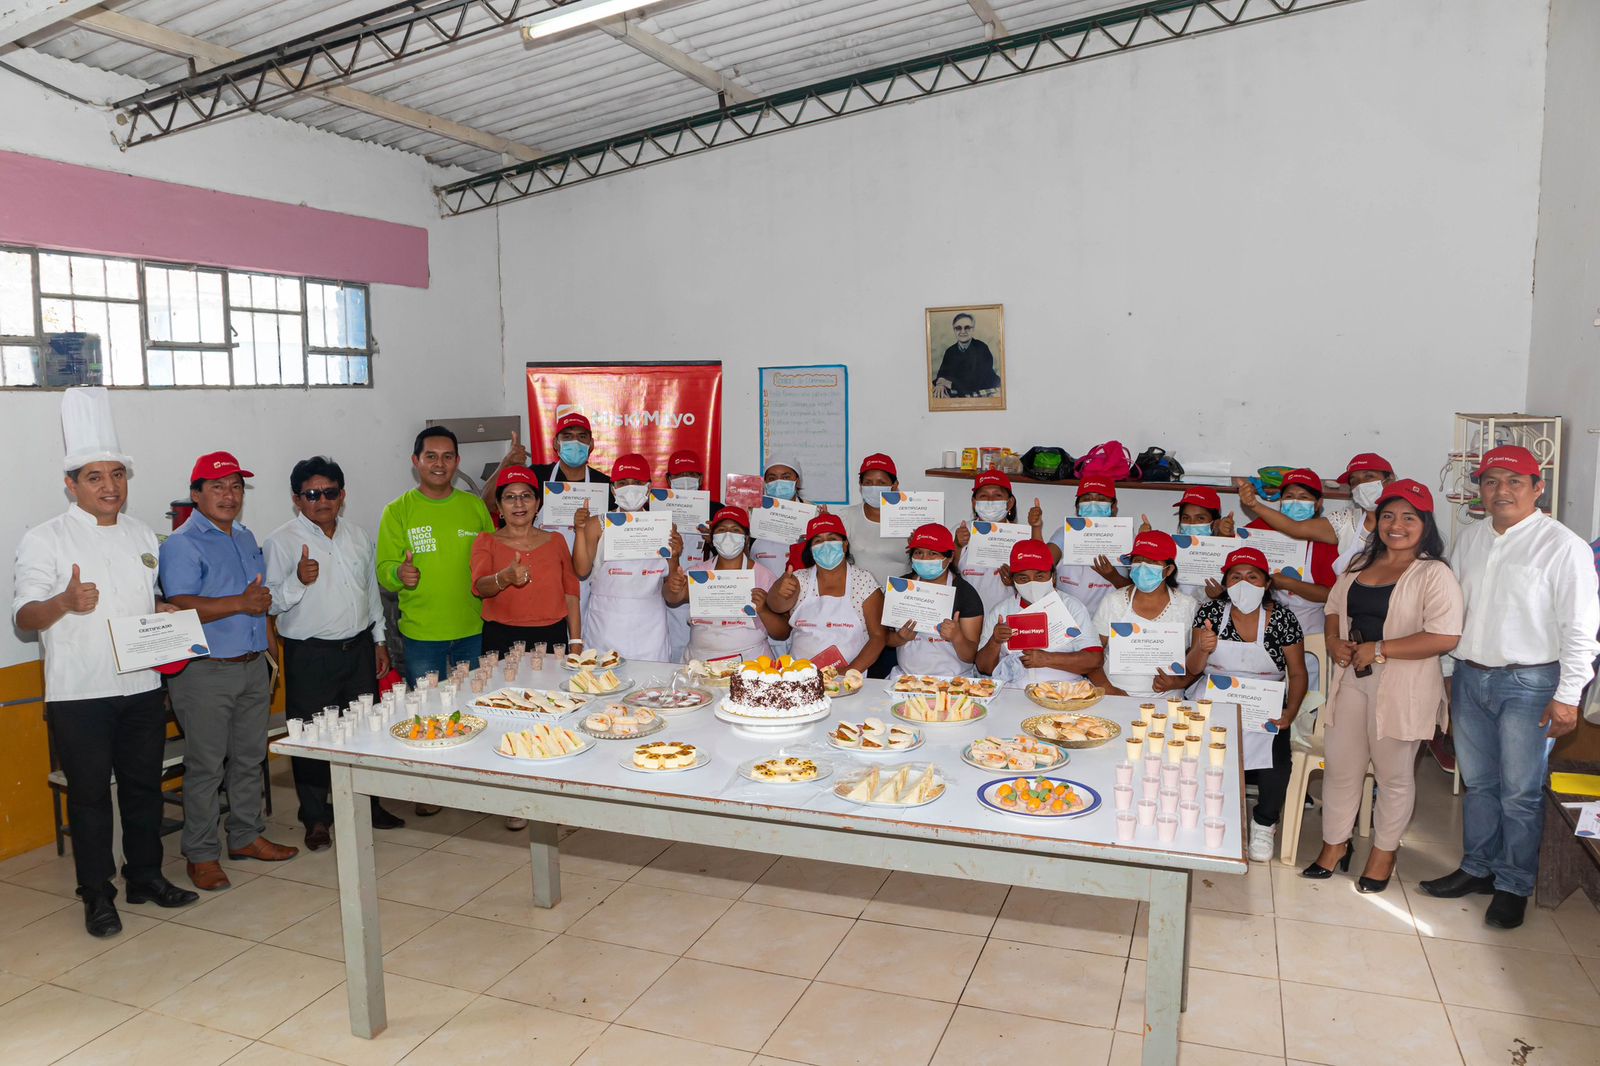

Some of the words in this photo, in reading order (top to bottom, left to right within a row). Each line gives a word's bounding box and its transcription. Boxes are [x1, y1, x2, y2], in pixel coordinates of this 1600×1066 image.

[411, 525, 432, 534] RECO
[412, 532, 431, 540] NOCI
[413, 538, 436, 546] MIENTO
[415, 544, 437, 553] 2023
[903, 595, 935, 604] CERTIFICADO
[138, 623, 173, 633] CERTIFICADO
[1226, 693, 1262, 701] CERTIFICADO
